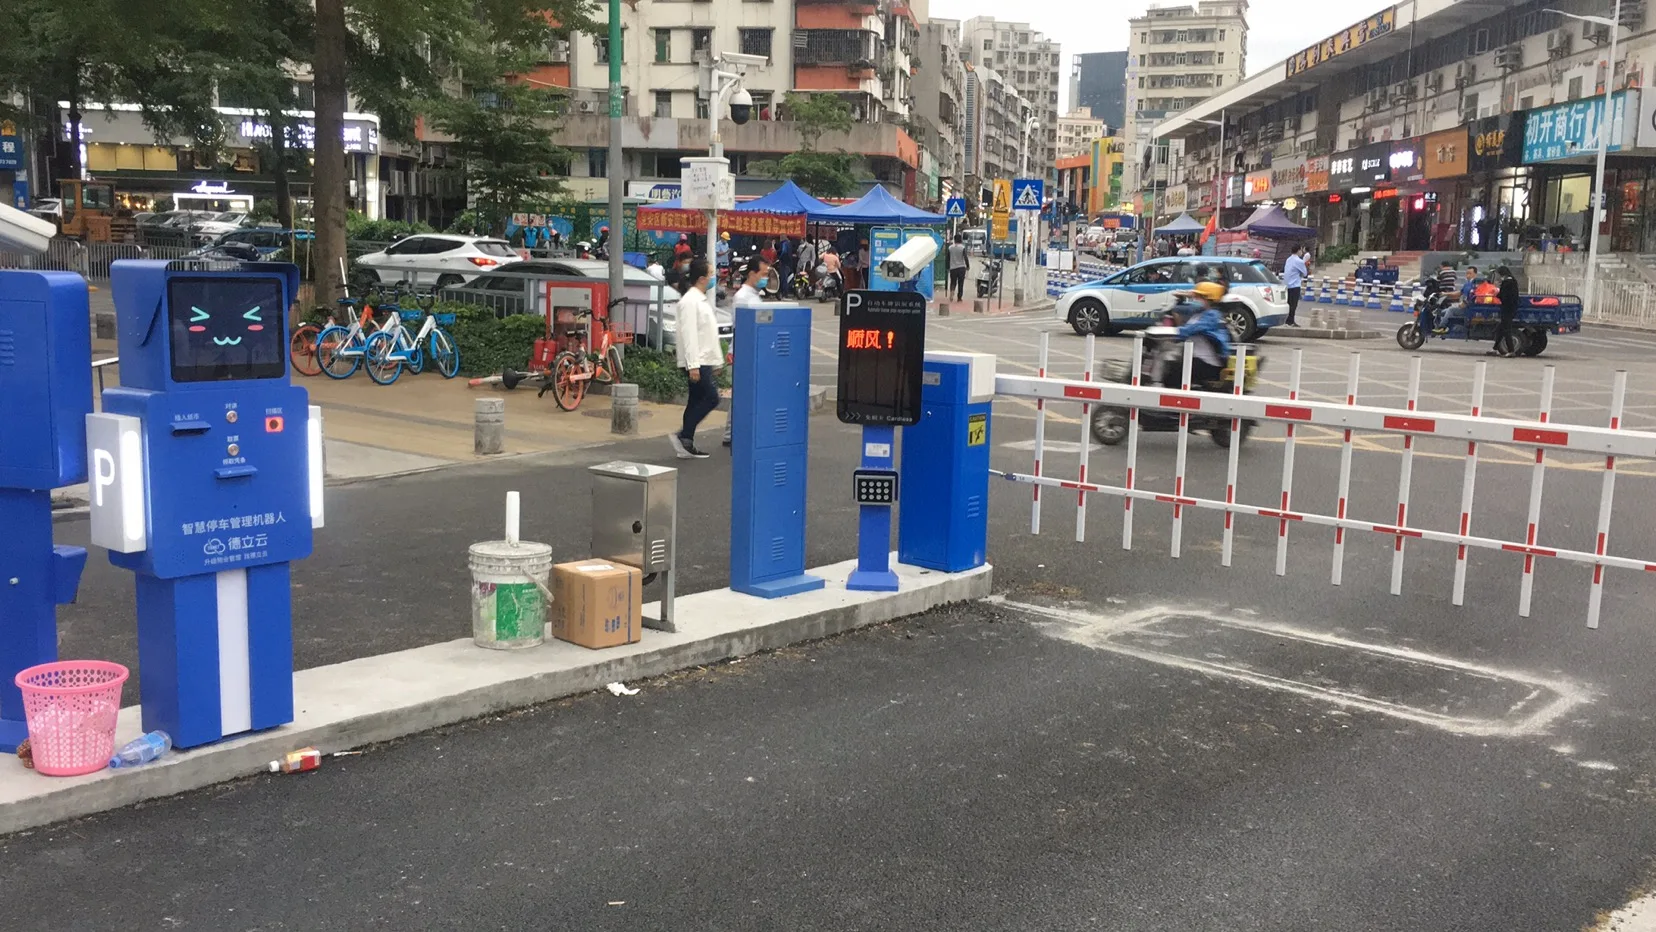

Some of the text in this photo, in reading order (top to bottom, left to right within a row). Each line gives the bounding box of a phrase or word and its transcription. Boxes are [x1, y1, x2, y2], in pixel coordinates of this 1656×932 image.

[1526, 102, 1584, 146] 初开商行
[846, 293, 862, 315] P
[94, 448, 115, 507] P
[182, 512, 286, 535] 智慧停车管理机器人
[228, 533, 268, 551] 德立云
